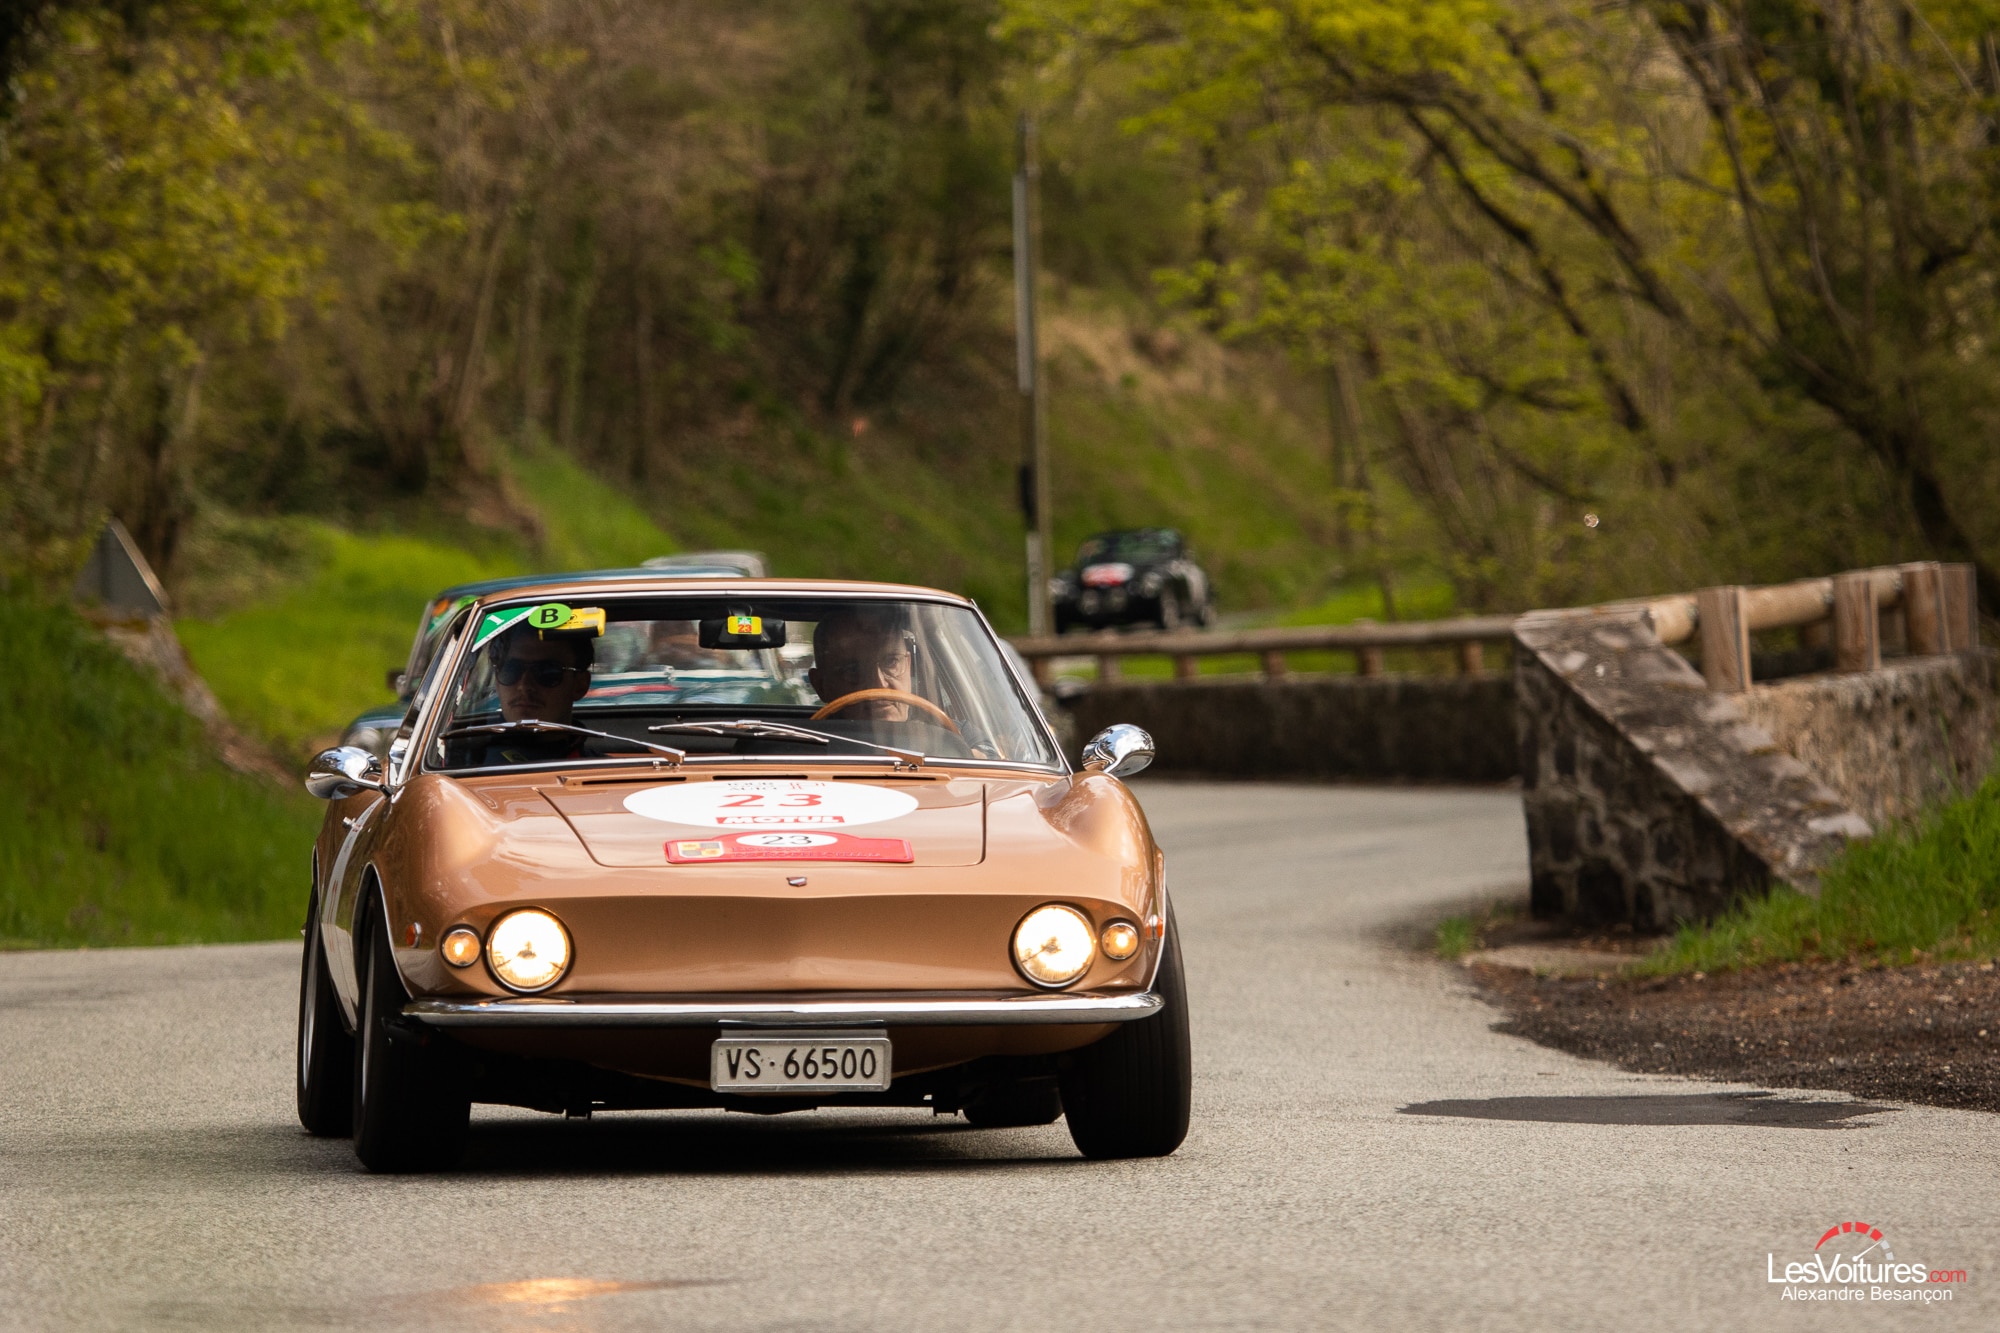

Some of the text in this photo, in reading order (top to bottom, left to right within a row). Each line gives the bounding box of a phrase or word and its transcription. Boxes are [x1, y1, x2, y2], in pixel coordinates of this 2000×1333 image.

[487, 614, 505, 626] 1
[540, 608, 559, 625] B
[738, 624, 752, 633] 23
[717, 793, 823, 808] 23
[724, 815, 840, 825] MOTUL
[761, 835, 812, 845] 23
